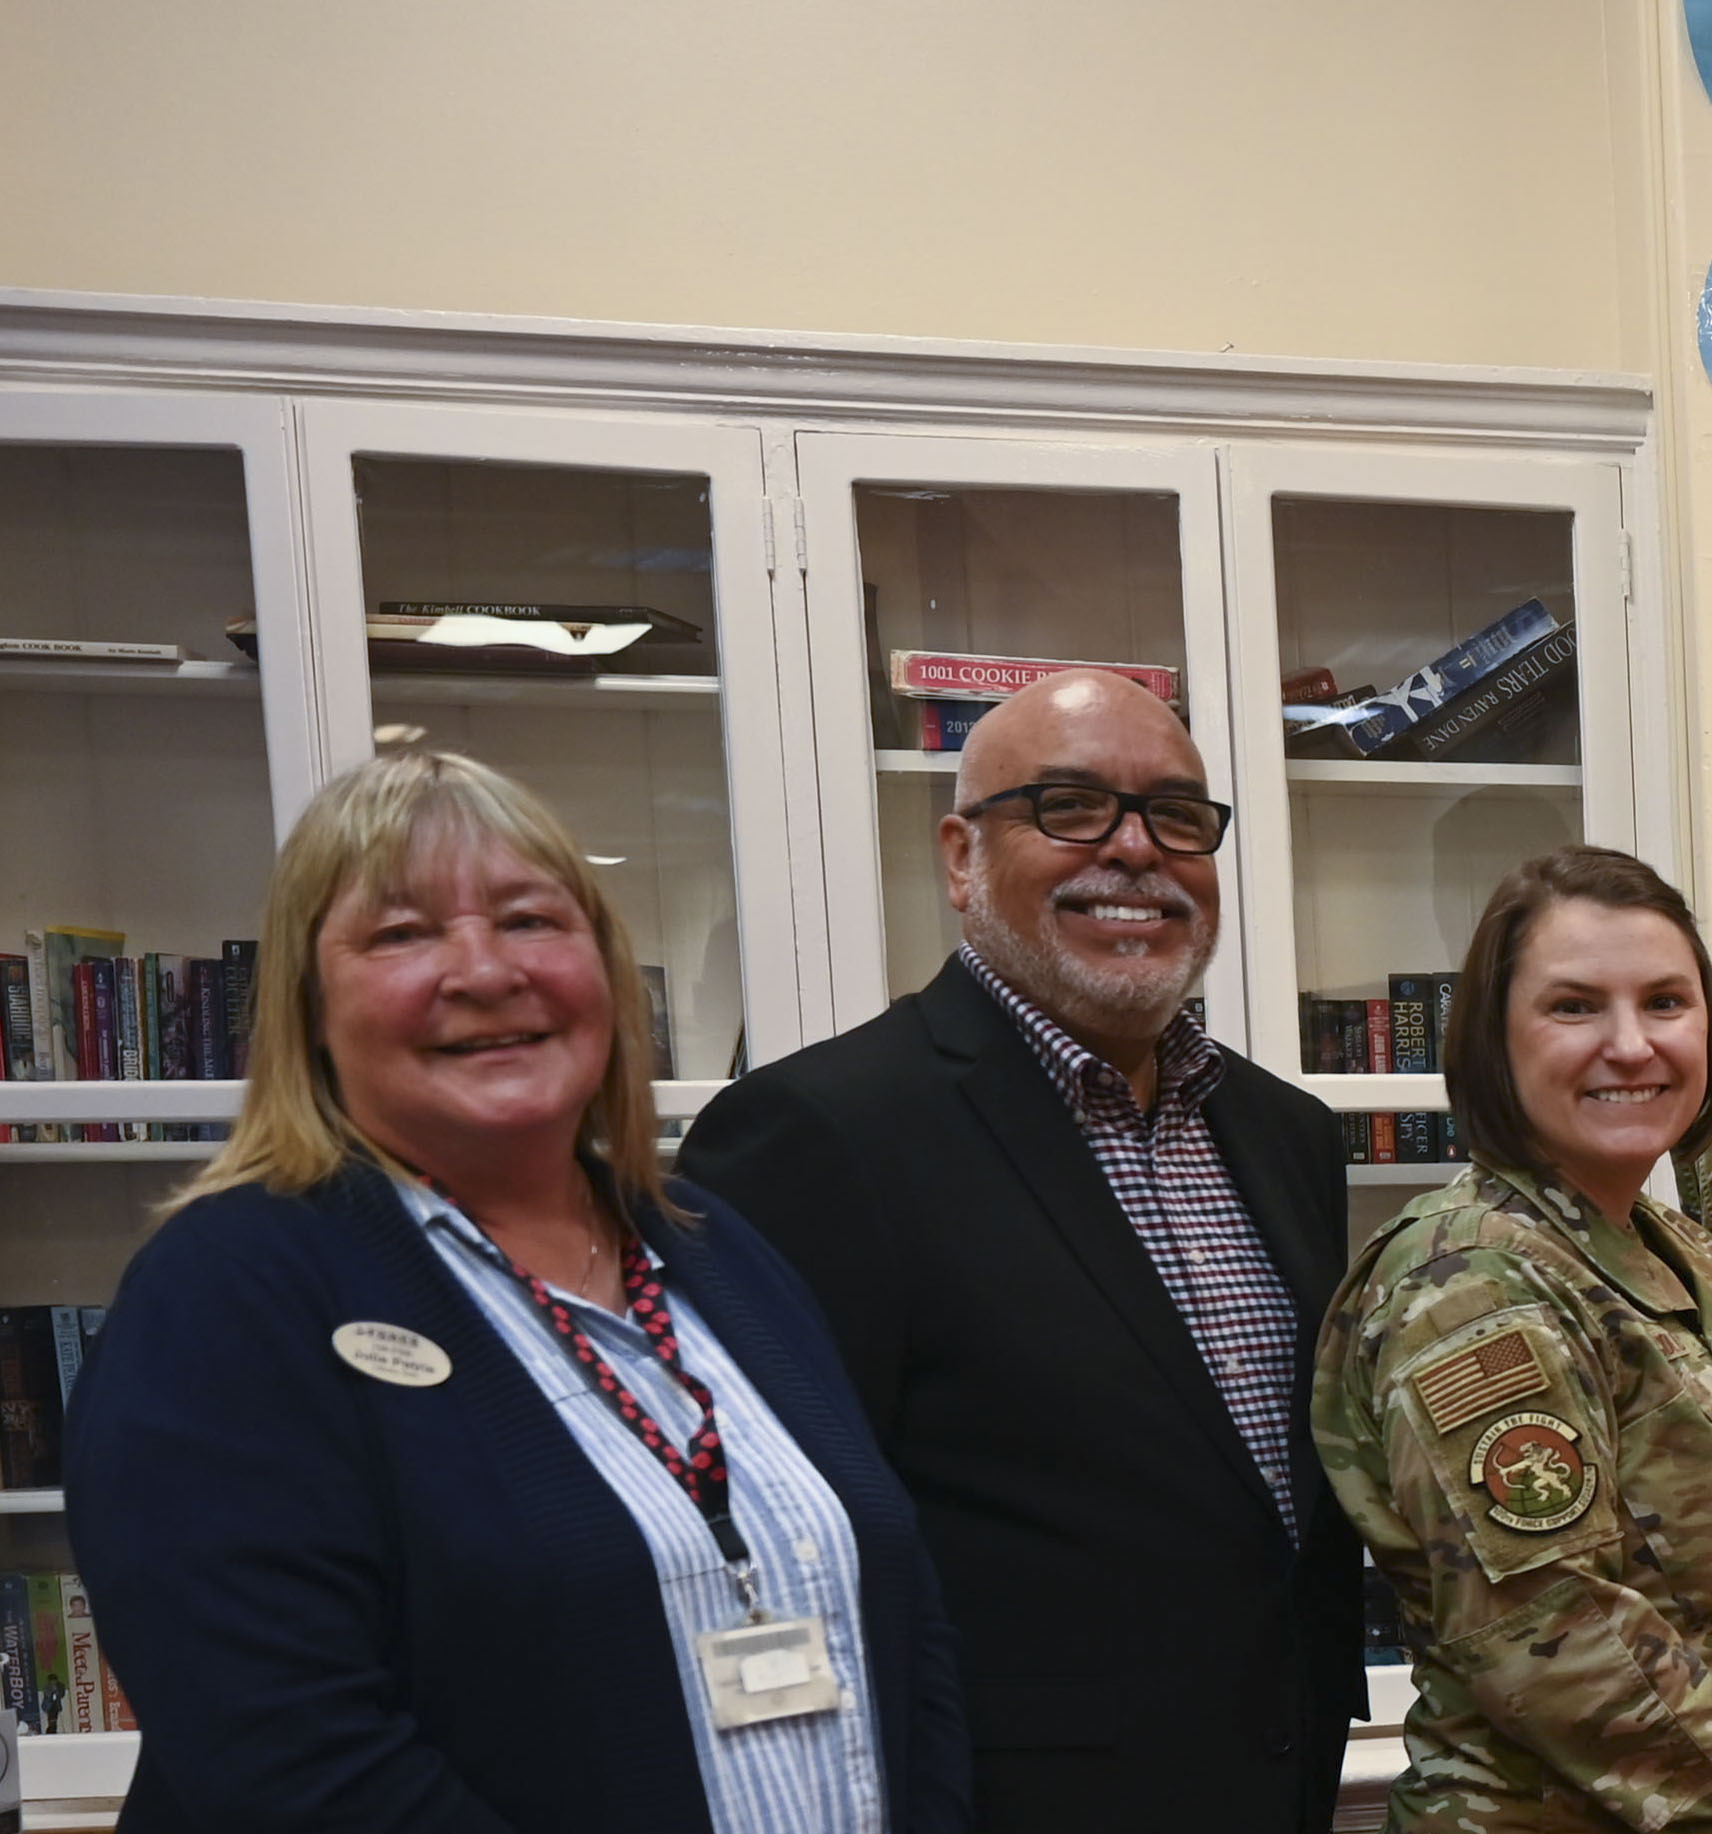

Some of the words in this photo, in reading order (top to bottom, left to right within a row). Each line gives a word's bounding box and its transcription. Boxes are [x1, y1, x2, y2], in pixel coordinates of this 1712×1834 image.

[466, 605, 541, 616] COOKBOOK
[919, 664, 954, 680] 1001
[958, 667, 1031, 685] COOKIE
[1496, 659, 1549, 701] TEARS
[1457, 692, 1499, 730] RAVEN
[1423, 719, 1461, 750] DANE
[1393, 1001, 1412, 1071] HARRIS
[1408, 1001, 1427, 1069] ROBERT
[1504, 1415, 1523, 1427] THE
[1529, 1414, 1561, 1430] FIGHT
